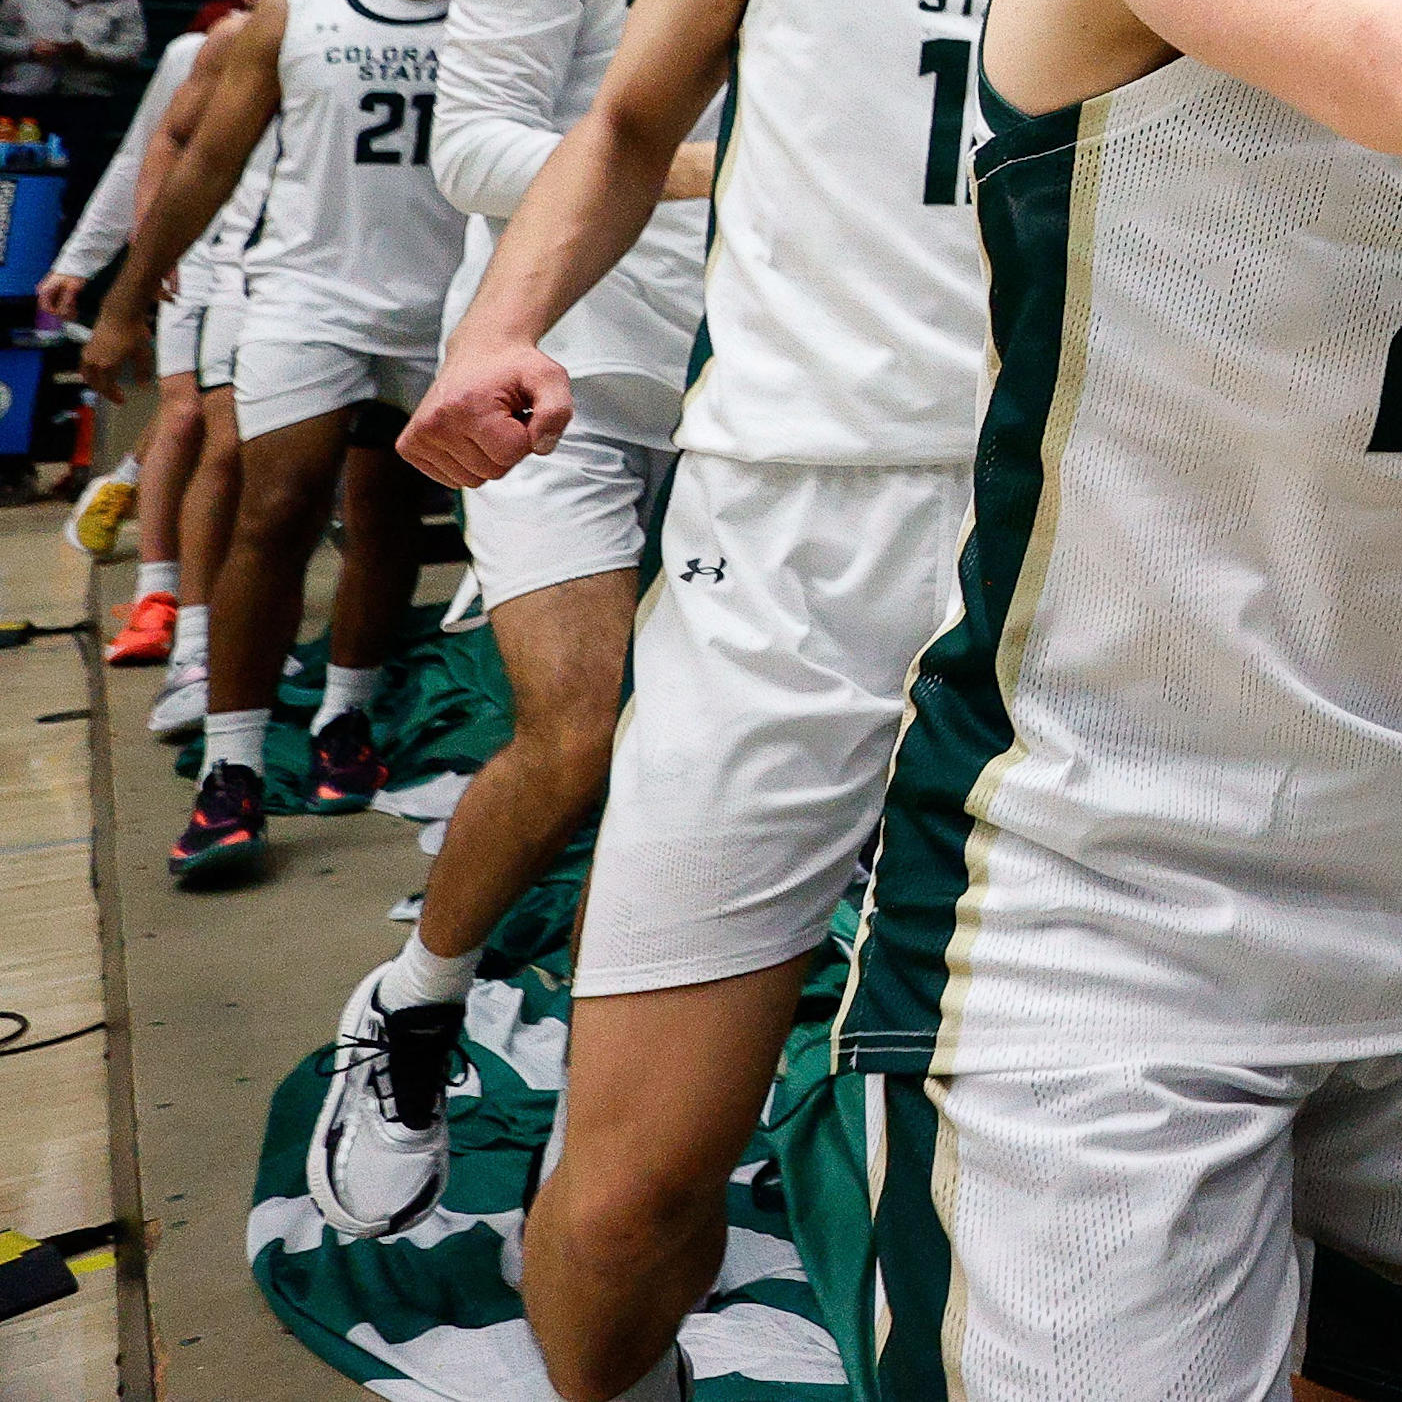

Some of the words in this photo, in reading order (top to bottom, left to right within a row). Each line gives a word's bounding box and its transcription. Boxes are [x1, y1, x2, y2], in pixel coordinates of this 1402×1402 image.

[325, 47, 439, 68] COLORA
[356, 92, 436, 165] 21
[919, 38, 973, 206] 1
